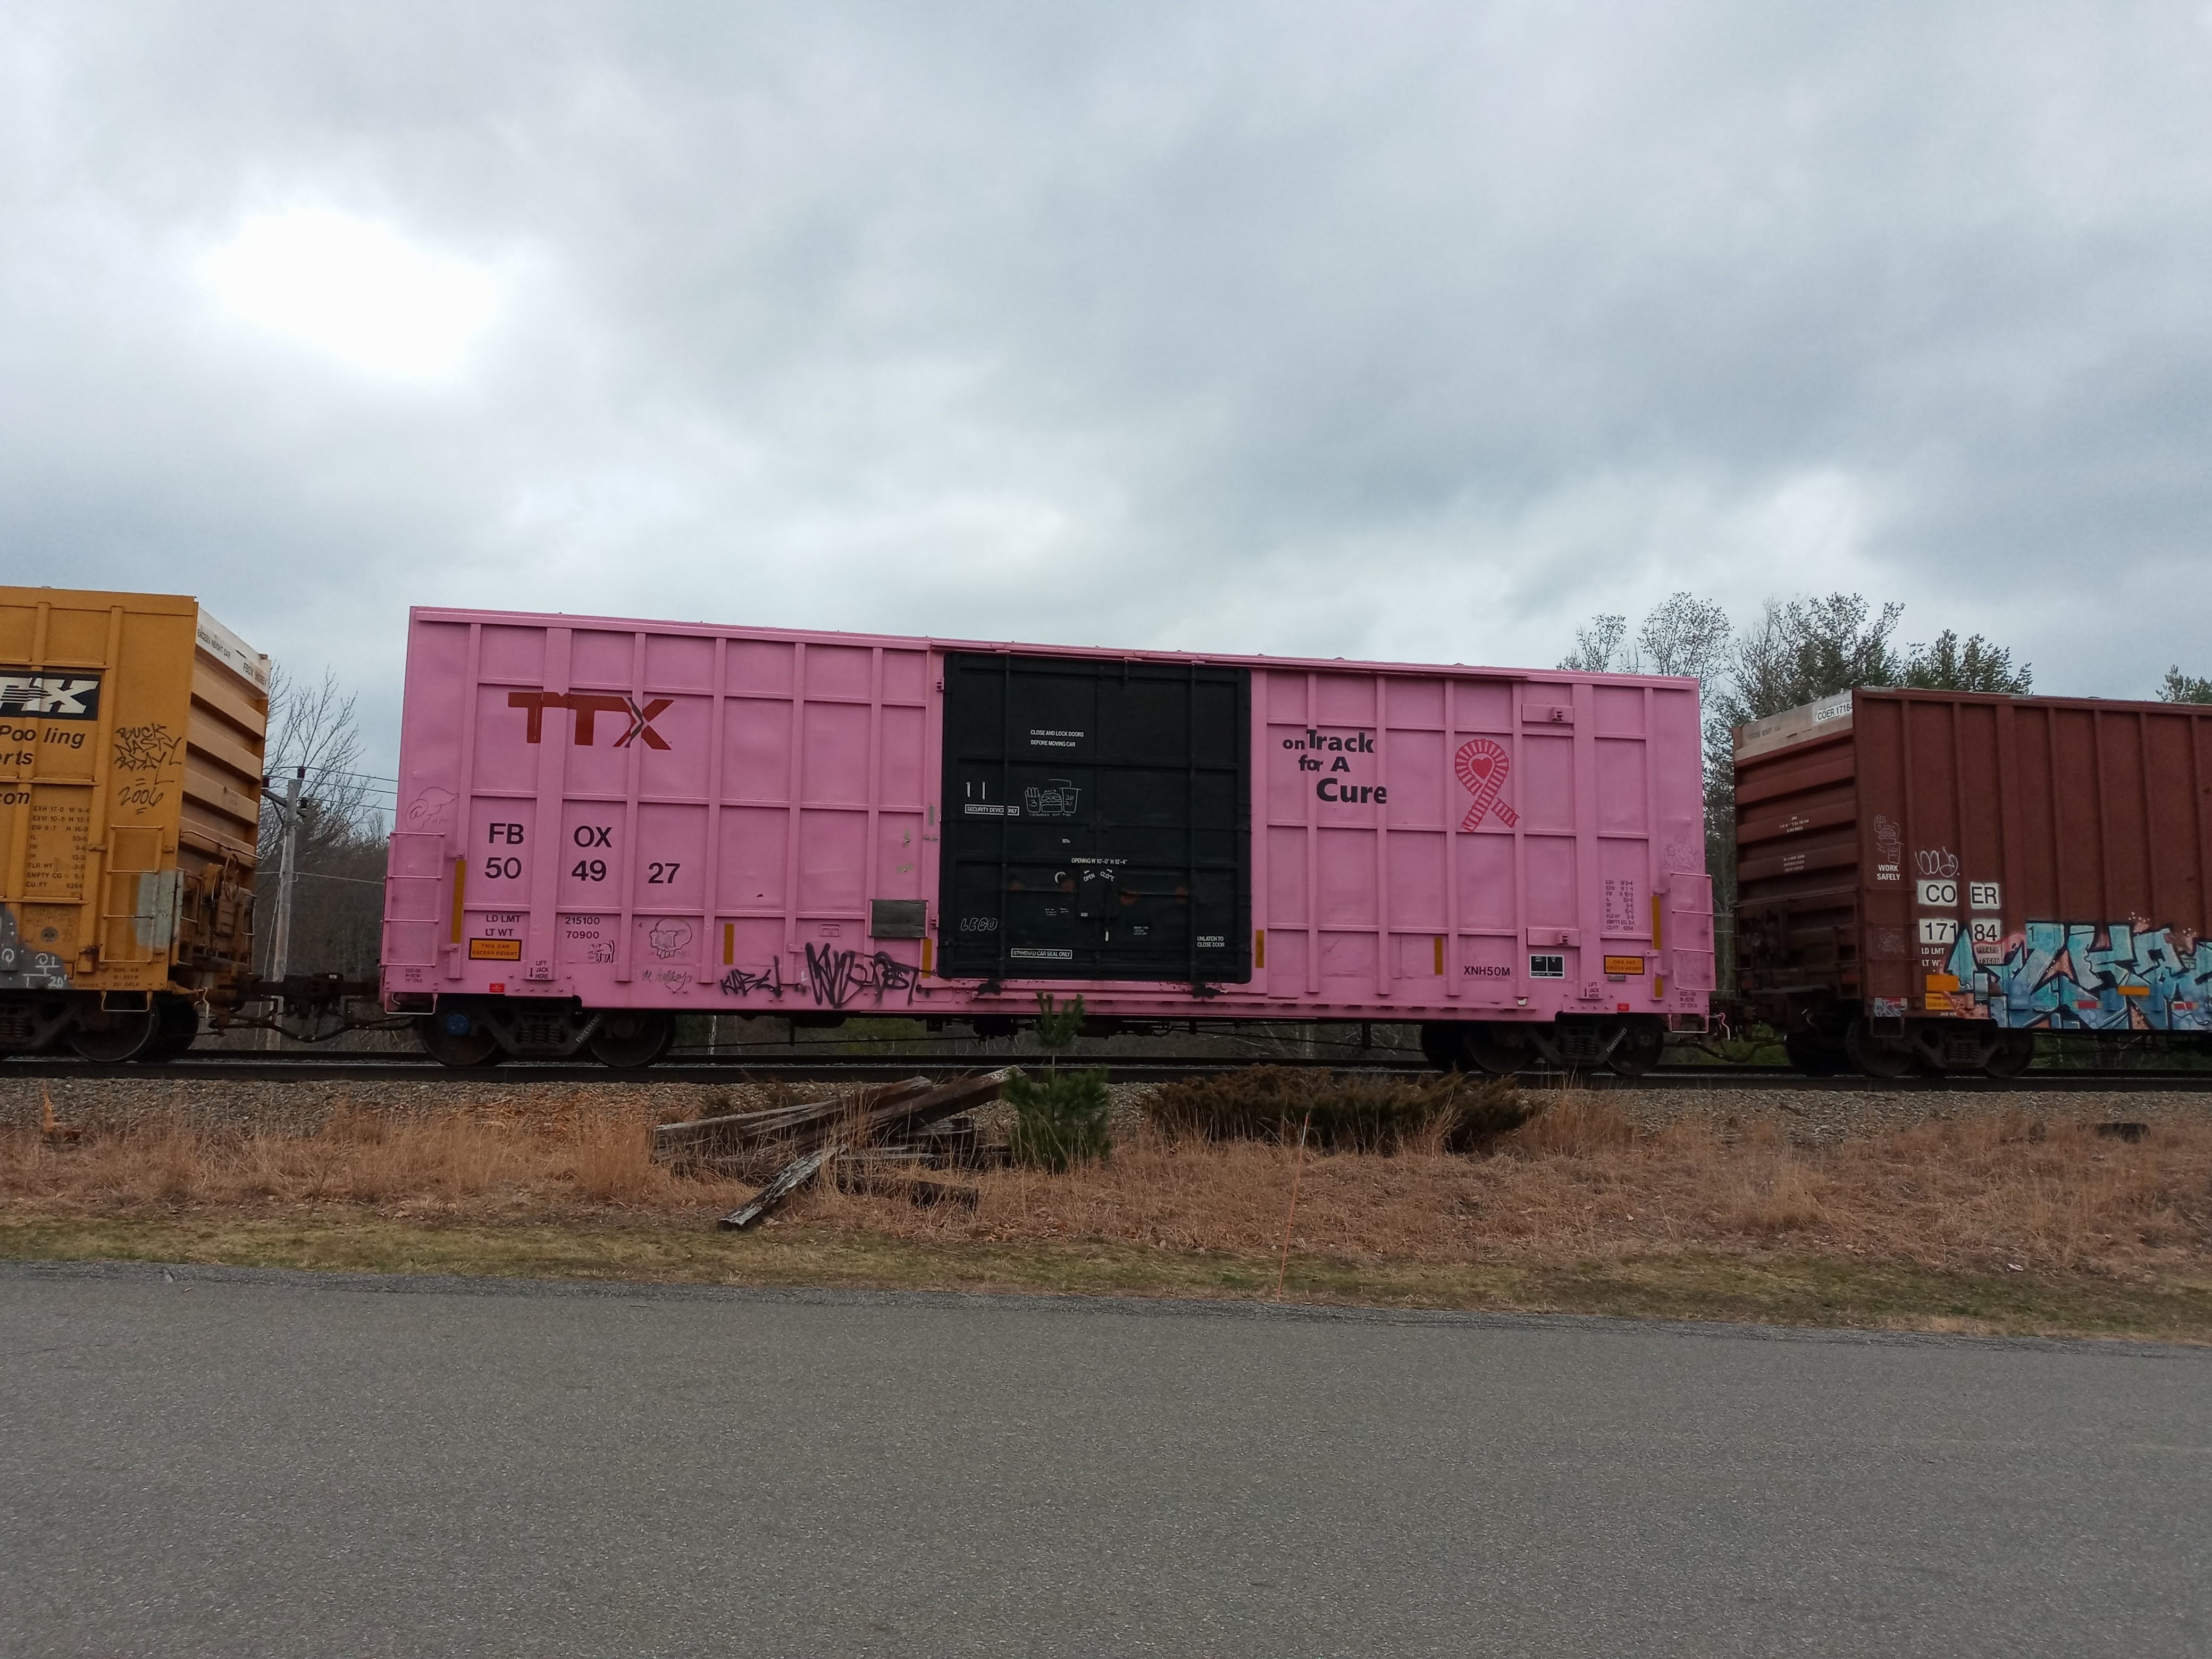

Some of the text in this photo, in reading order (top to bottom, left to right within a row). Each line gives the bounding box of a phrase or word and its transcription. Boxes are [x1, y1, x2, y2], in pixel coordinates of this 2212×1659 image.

[508, 692, 674, 750] TTX
[1817, 709, 1834, 720] COER
[0, 750, 34, 765] rts
[1298, 754, 1351, 773] for A
[0, 792, 30, 805] on
[118, 786, 164, 807] 2006
[1317, 777, 1387, 804] Cure
[488, 823, 613, 848] FB OX
[484, 857, 681, 884] 50 49 27
[1083, 873, 1096, 882] OPEN
[1925, 884, 1998, 904] CO ER
[565, 916, 600, 925] 215100
[566, 931, 599, 939] 70900
[1925, 922, 1998, 942] 171 84
[1464, 966, 1510, 976] XNH50M
